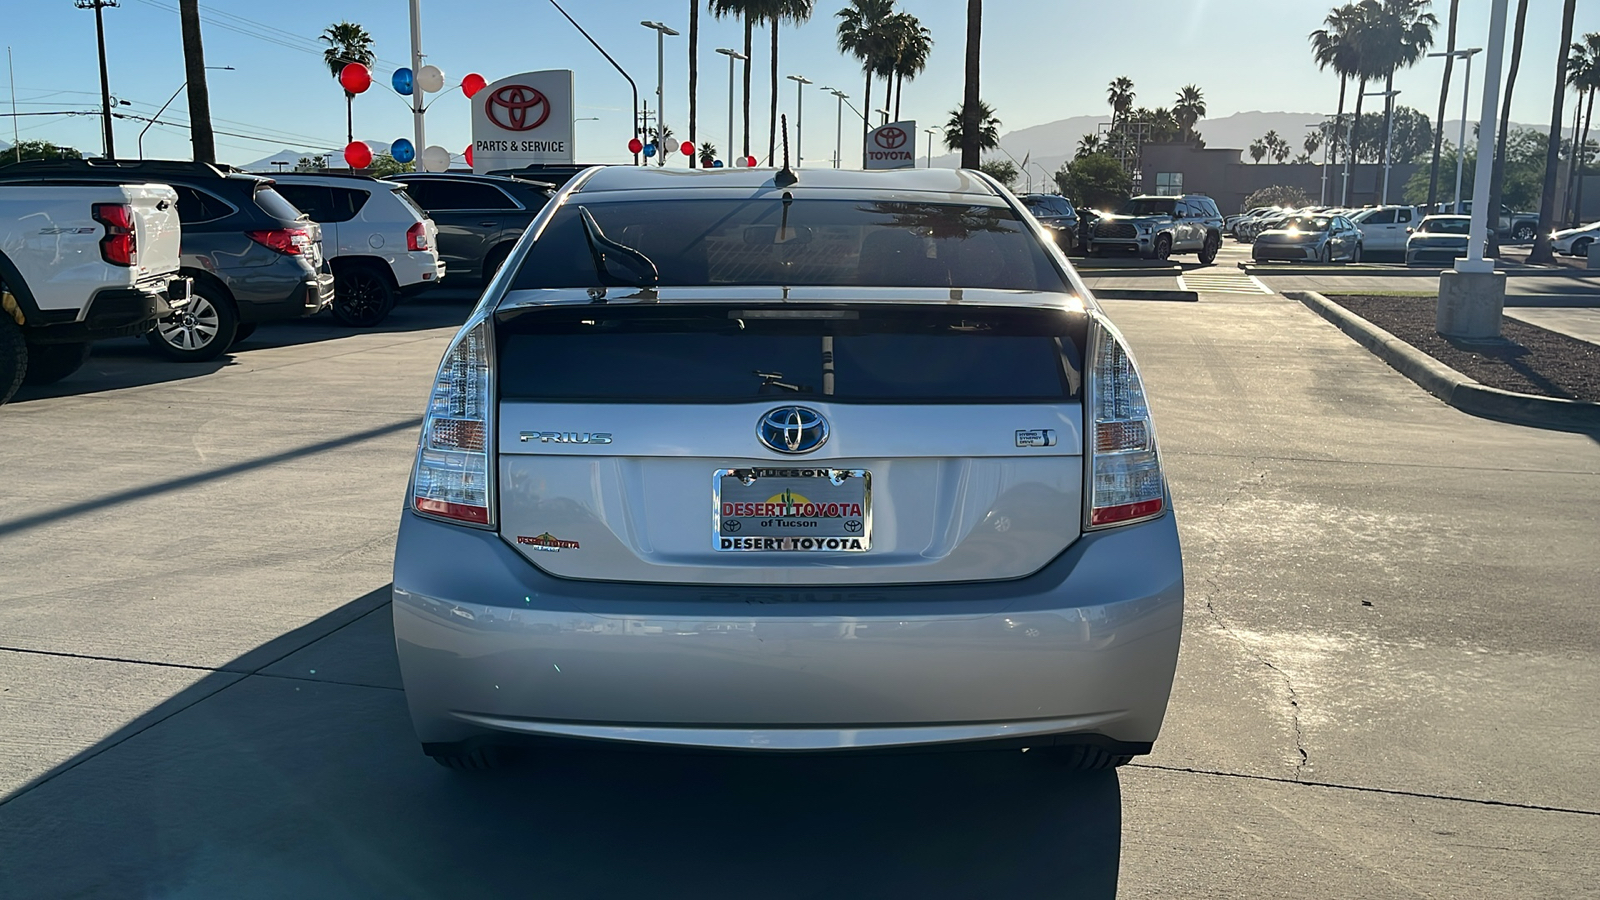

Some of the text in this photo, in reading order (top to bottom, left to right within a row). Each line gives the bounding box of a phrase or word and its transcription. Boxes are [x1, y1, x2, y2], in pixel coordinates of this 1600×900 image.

[476, 140, 564, 152] PARTS & SERVICE
[868, 151, 912, 160] TOYOTA
[520, 430, 613, 444] PRIUS
[757, 468, 829, 478] TUCSON
[722, 502, 862, 517] DESERT TOYOTA
[760, 518, 818, 528] of Tucson
[721, 538, 862, 550] DESERT TOYOTA
